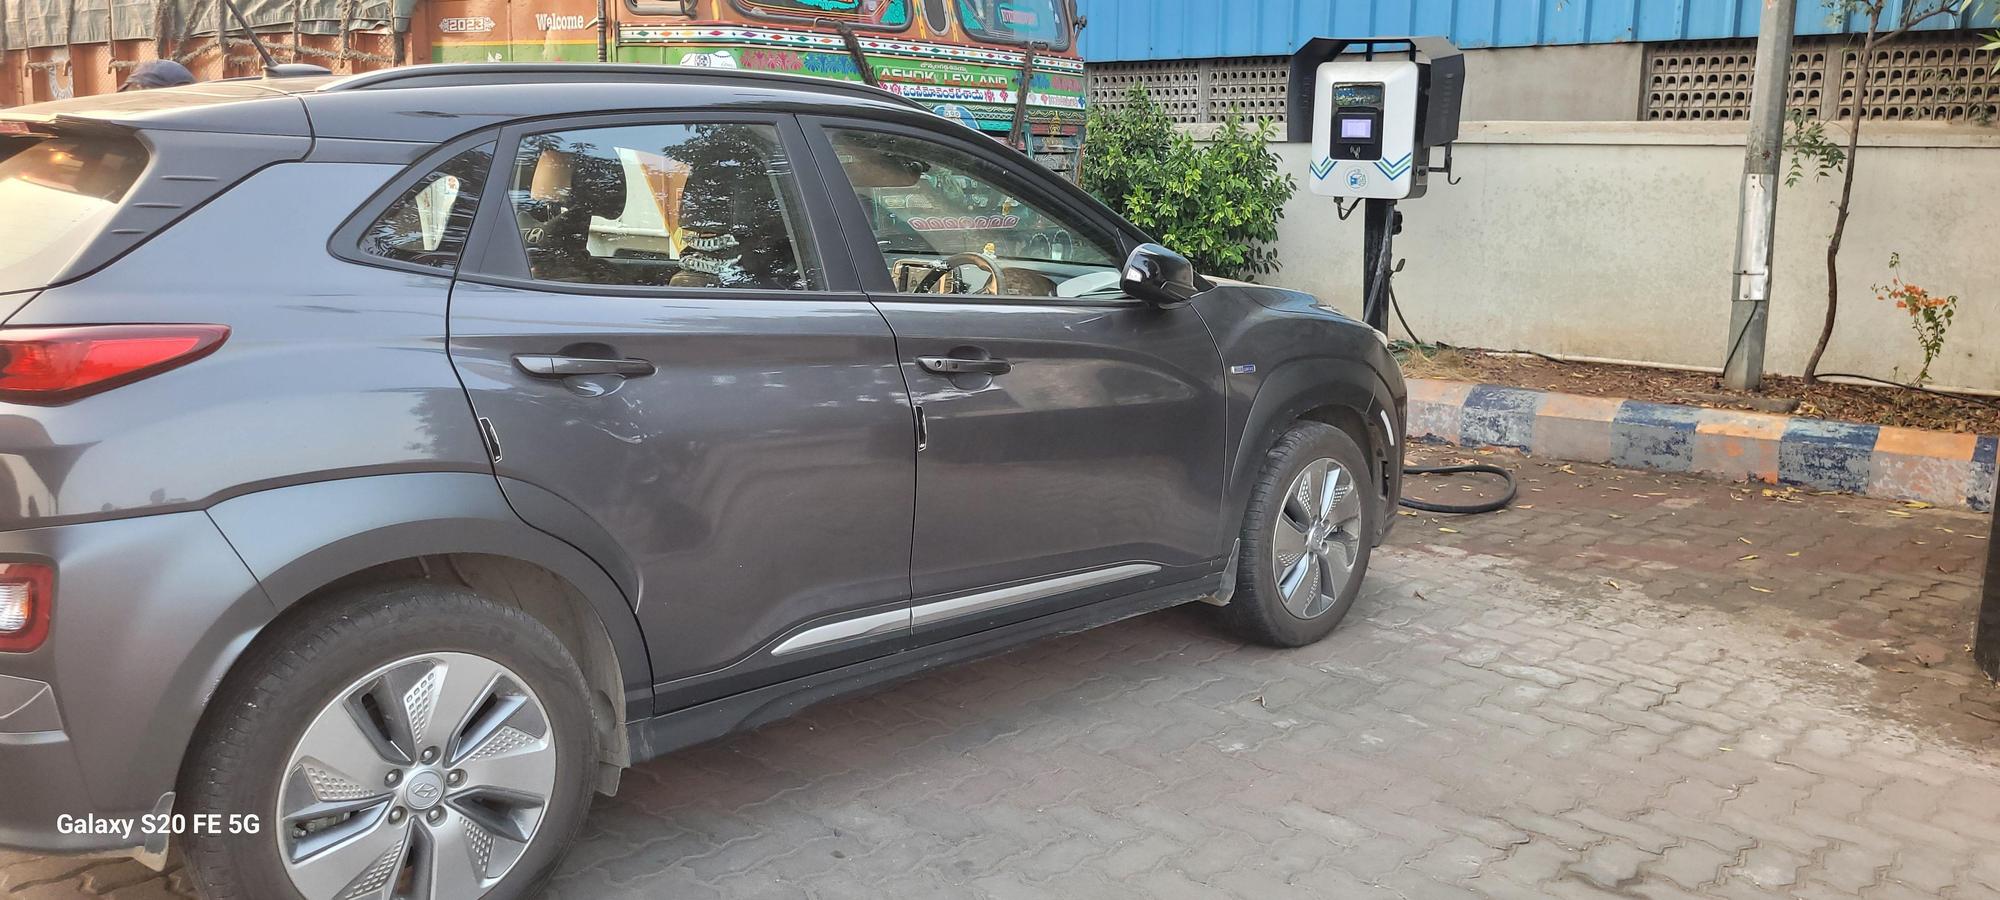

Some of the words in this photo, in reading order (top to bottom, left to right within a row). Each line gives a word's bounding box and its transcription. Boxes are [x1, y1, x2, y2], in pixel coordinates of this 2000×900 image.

[449, 18, 485, 31] 2023
[535, 13, 584, 31] Welcome
[880, 67, 937, 84] ASHOK
[943, 71, 1008, 89] LEYLAND
